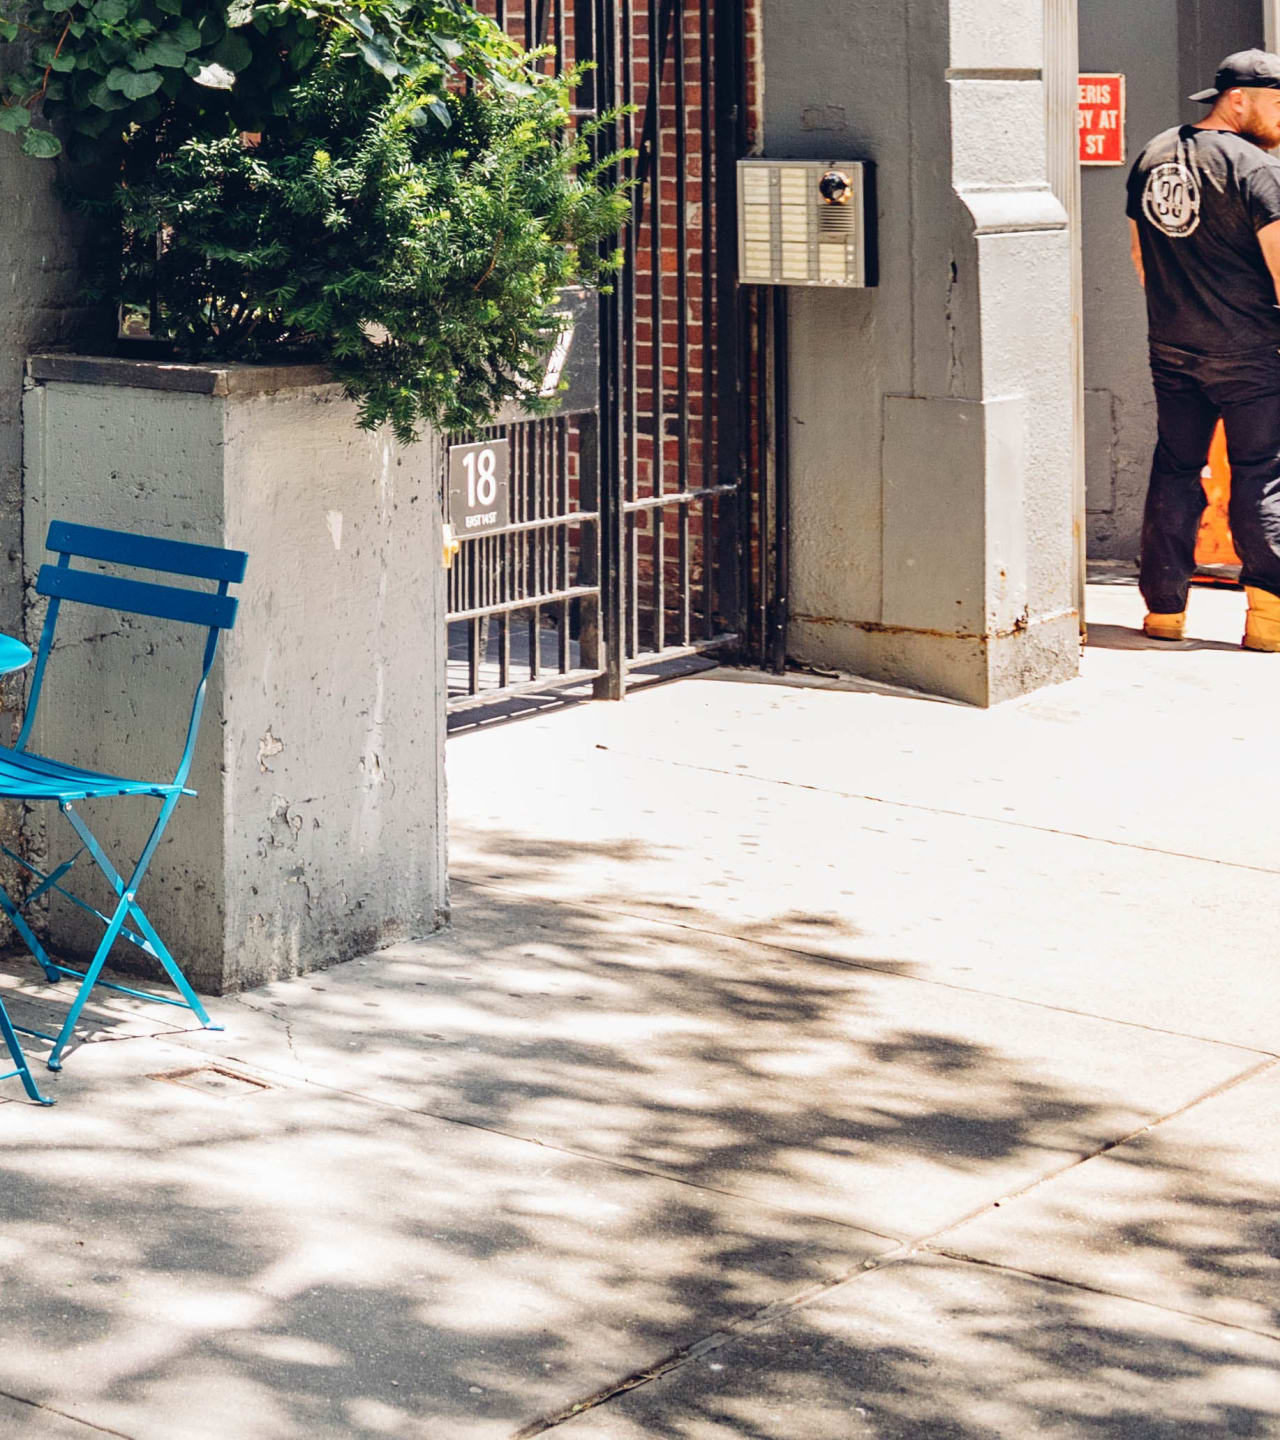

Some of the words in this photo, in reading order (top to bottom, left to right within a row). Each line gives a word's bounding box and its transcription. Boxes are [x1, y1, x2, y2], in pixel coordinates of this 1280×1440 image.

[1099, 110, 1119, 128] AT
[1085, 134, 1105, 154] ST
[462, 448, 497, 508] 18
